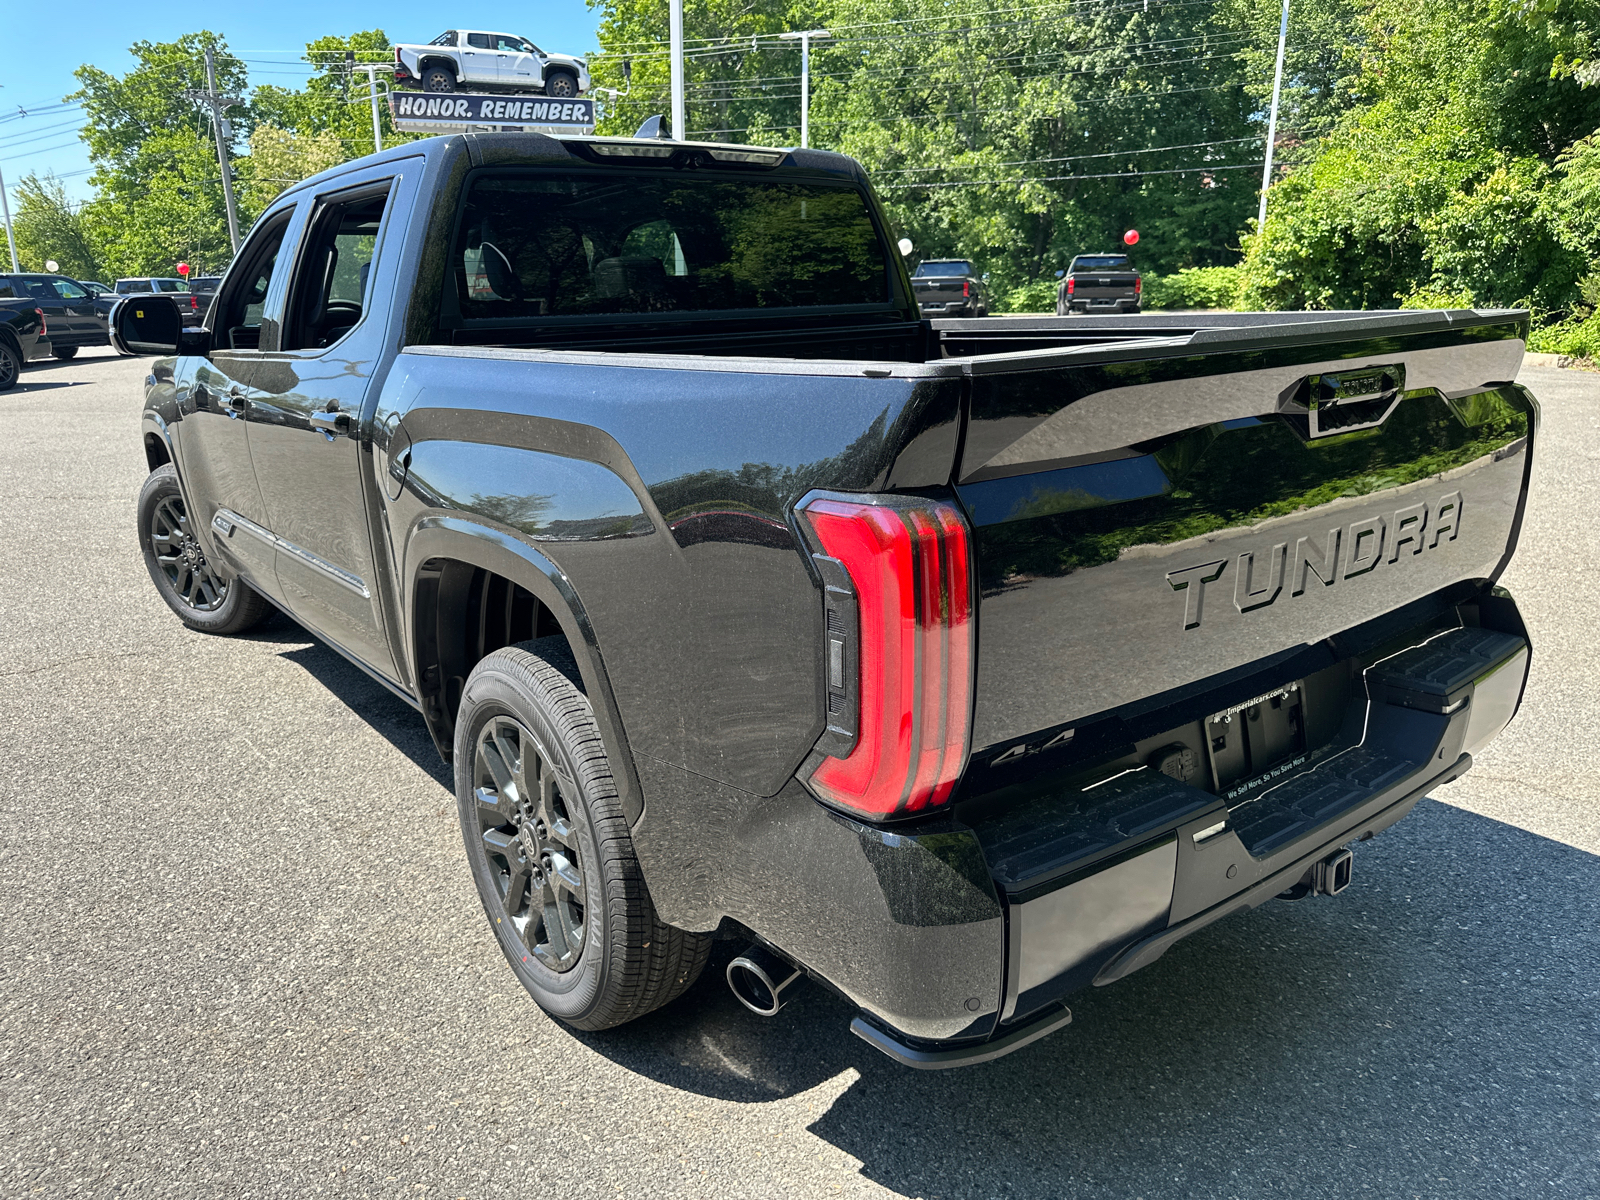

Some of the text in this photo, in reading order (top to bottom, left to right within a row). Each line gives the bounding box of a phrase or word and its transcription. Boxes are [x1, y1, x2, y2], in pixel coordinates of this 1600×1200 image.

[399, 97, 590, 122] HONOR. REMEMBER.
[1343, 376, 1381, 396] TOYOTA
[1166, 490, 1463, 631] TUNDRA
[1227, 688, 1284, 715] Imperialcars.com
[1227, 790, 1238, 799] We
[1237, 785, 1248, 795] Sell
[1263, 774, 1271, 782] So
[1270, 770, 1281, 778] You
[1280, 763, 1293, 773] Save
[1292, 756, 1305, 767] More
[578, 822, 601, 947] YOKOHAMA
